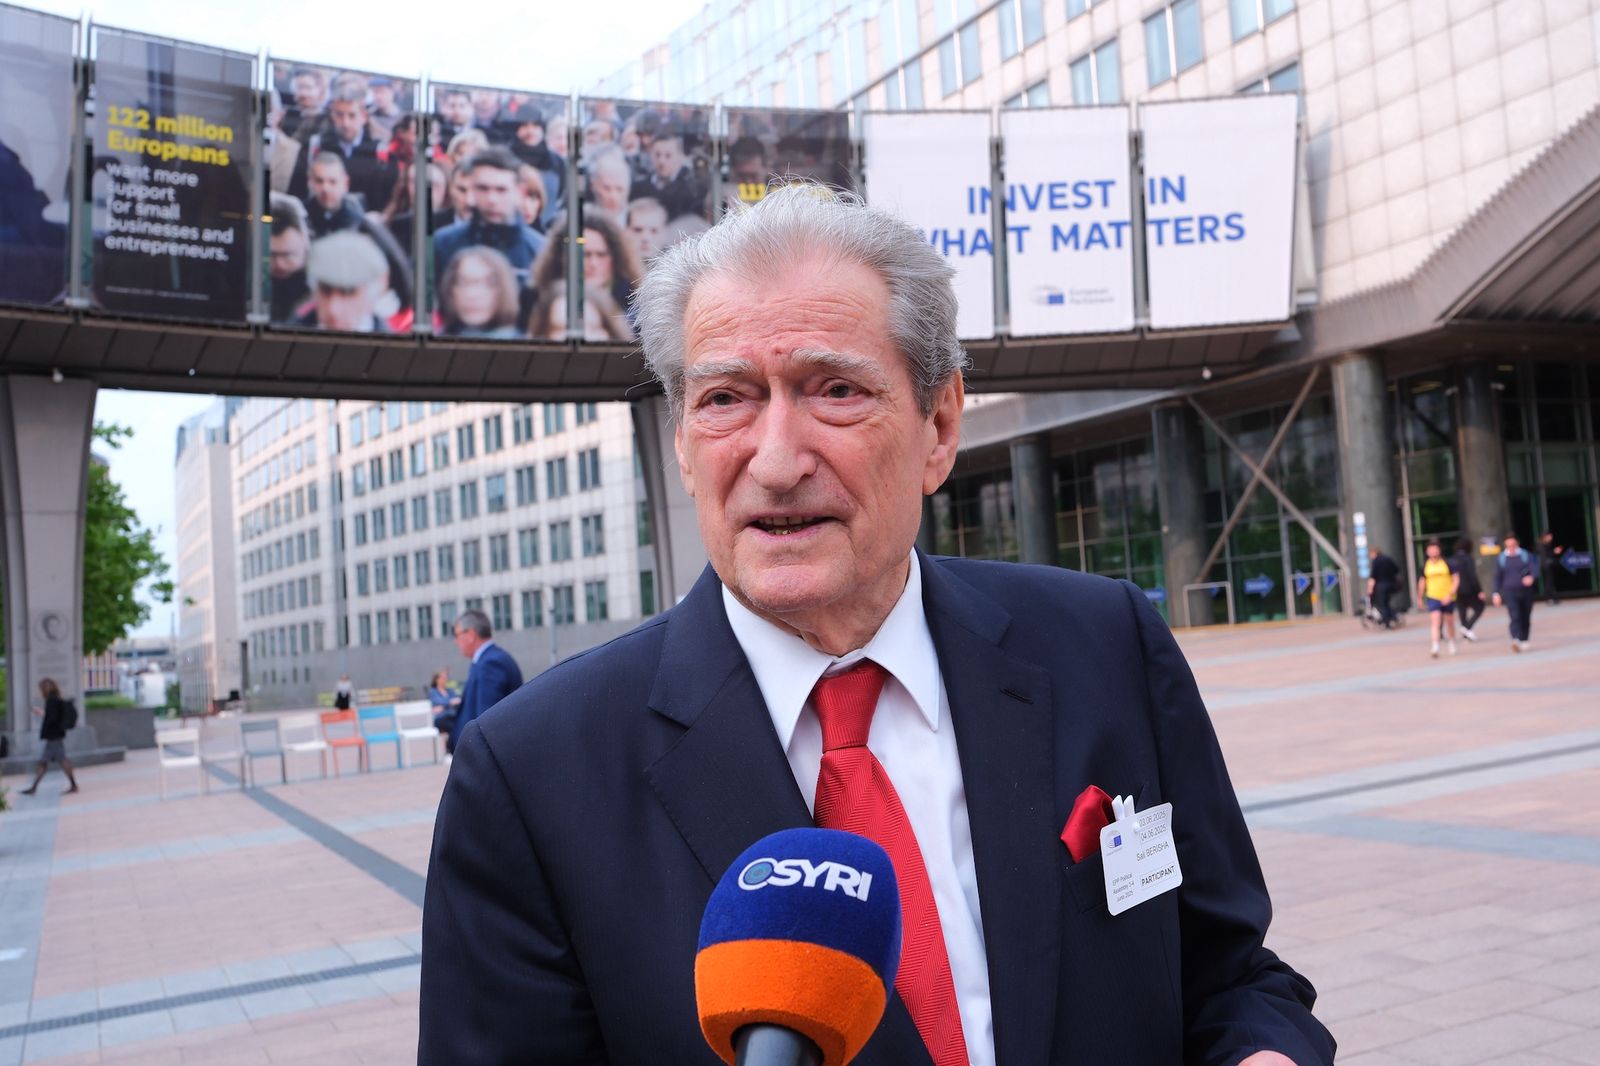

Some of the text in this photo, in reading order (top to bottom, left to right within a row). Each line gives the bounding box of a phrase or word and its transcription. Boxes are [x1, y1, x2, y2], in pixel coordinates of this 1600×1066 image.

[108, 105, 233, 142] 122 million
[108, 129, 230, 167] Europeans
[106, 161, 198, 187] want more
[106, 178, 176, 202] support
[969, 175, 1186, 214] INVEST IN
[135, 200, 180, 220] small
[106, 215, 234, 244] businesses and
[1052, 213, 1245, 251] MATTERS
[105, 235, 229, 261] entrepreneurs.
[1136, 851, 1146, 861] Sali
[1146, 841, 1169, 857] BERISHA
[1141, 865, 1175, 886] PARTICIPANT
